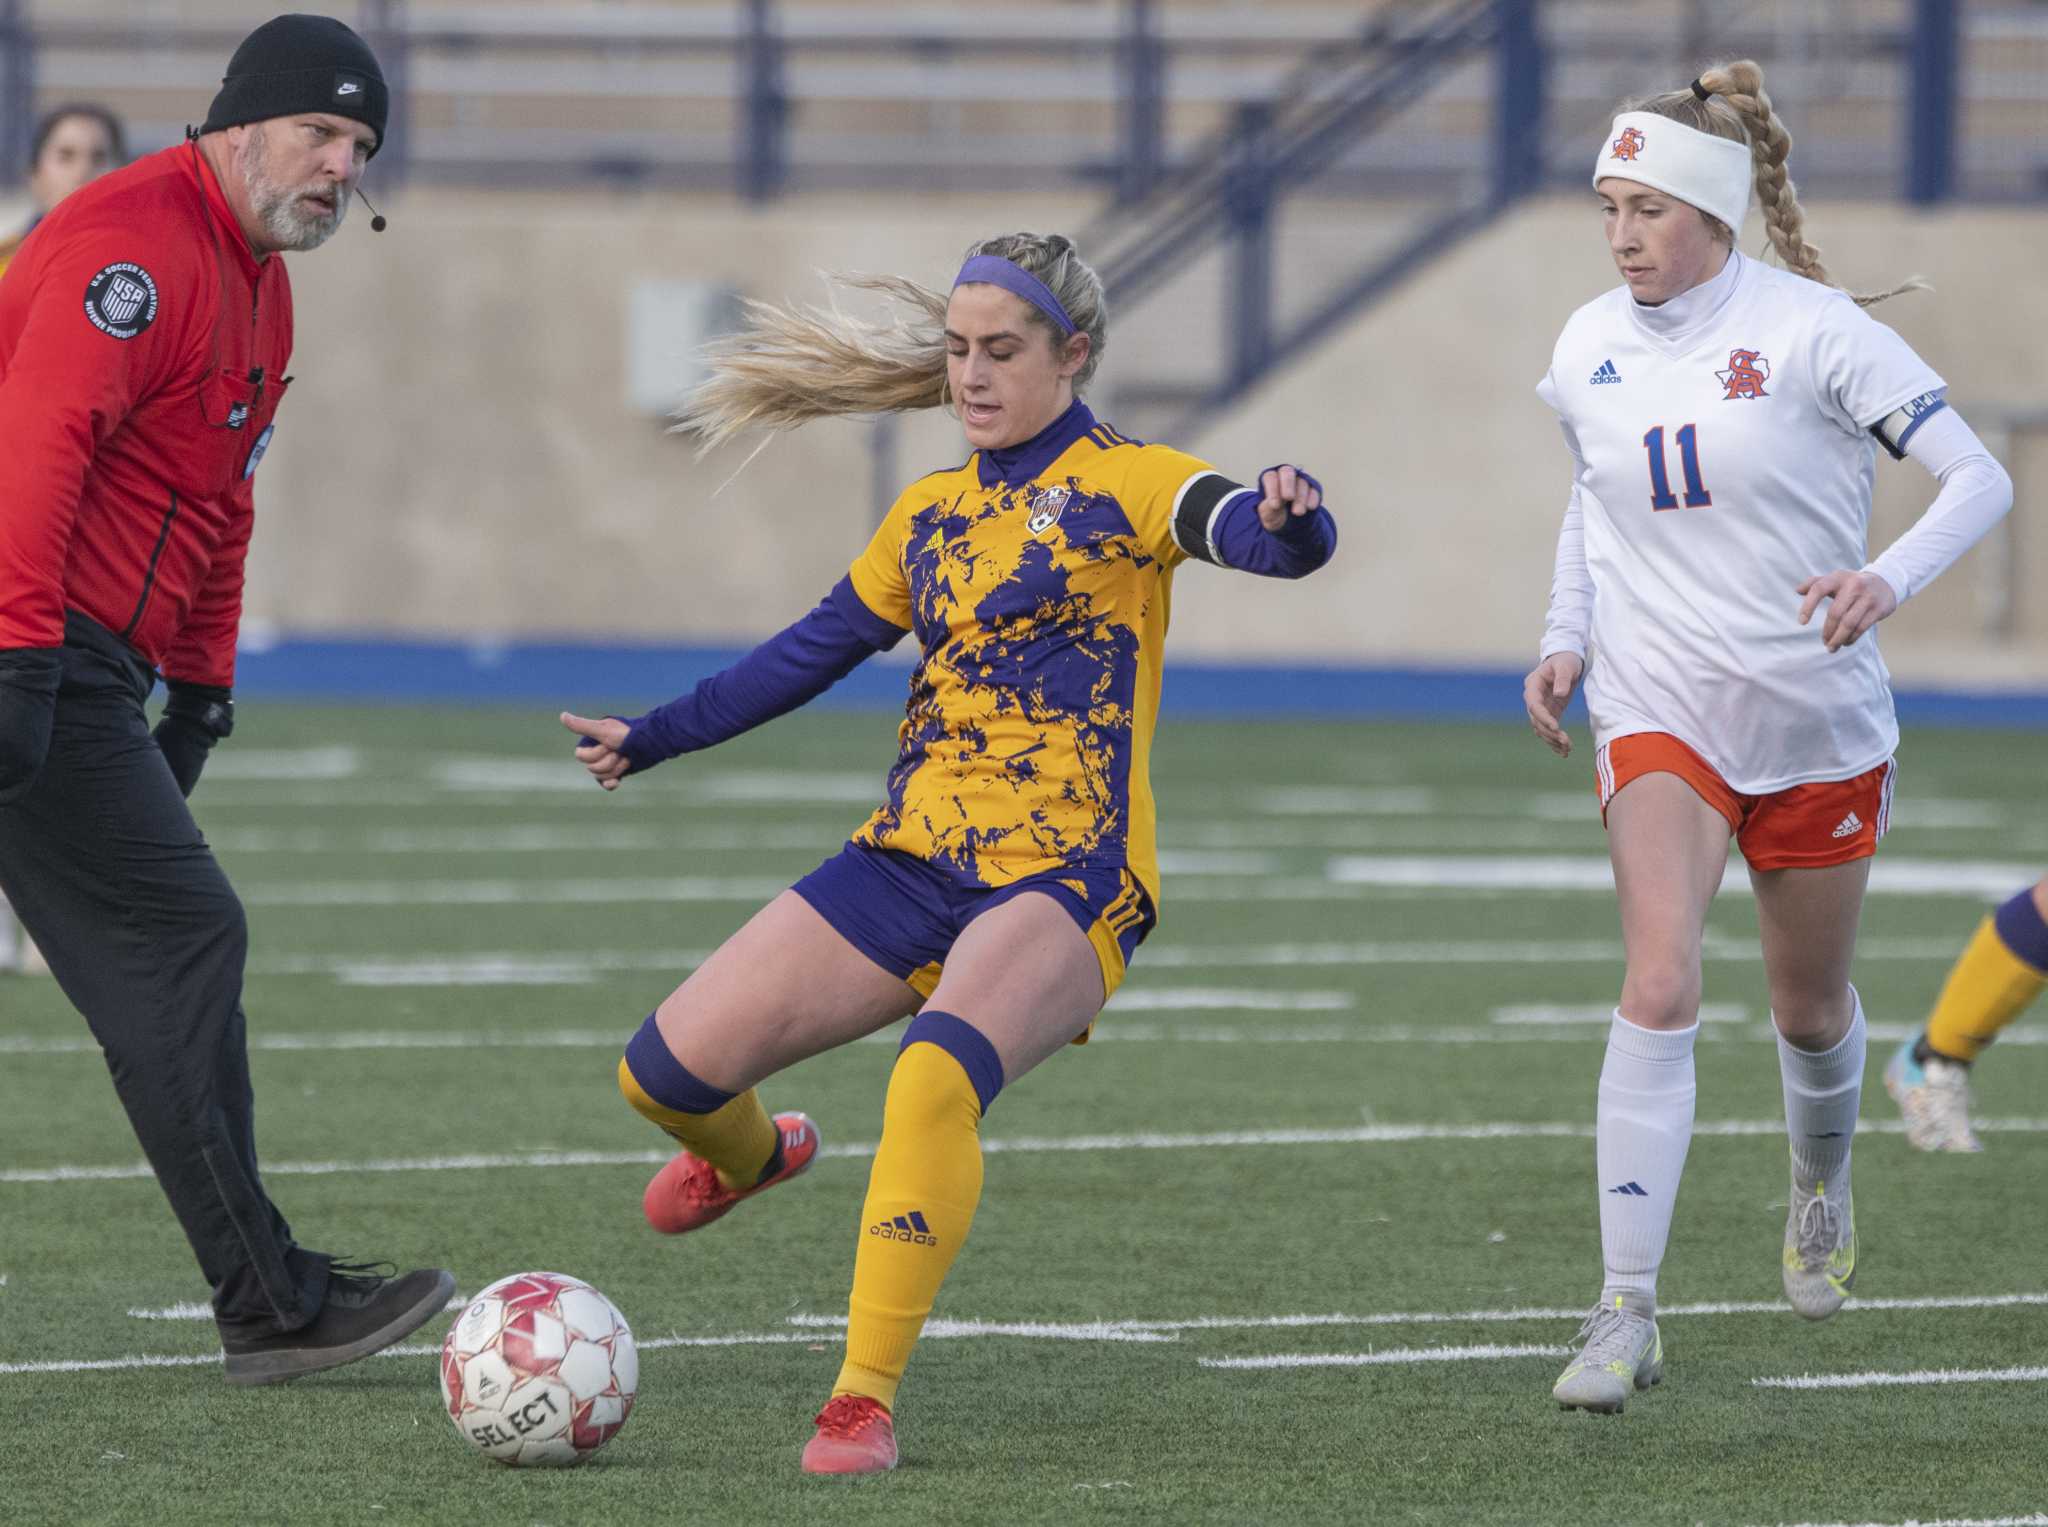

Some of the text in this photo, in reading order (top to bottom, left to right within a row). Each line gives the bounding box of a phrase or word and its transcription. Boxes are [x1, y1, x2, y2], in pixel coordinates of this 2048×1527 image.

[104, 263, 139, 275] SOCCER
[138, 269, 158, 322] FEDERATION
[113, 278, 144, 302] USA
[1589, 374, 1622, 385] adidas
[1643, 423, 1712, 512] 11
[1832, 821, 1863, 838] adidas
[870, 1222, 937, 1247] adidas
[471, 1391, 558, 1448] SELECT
